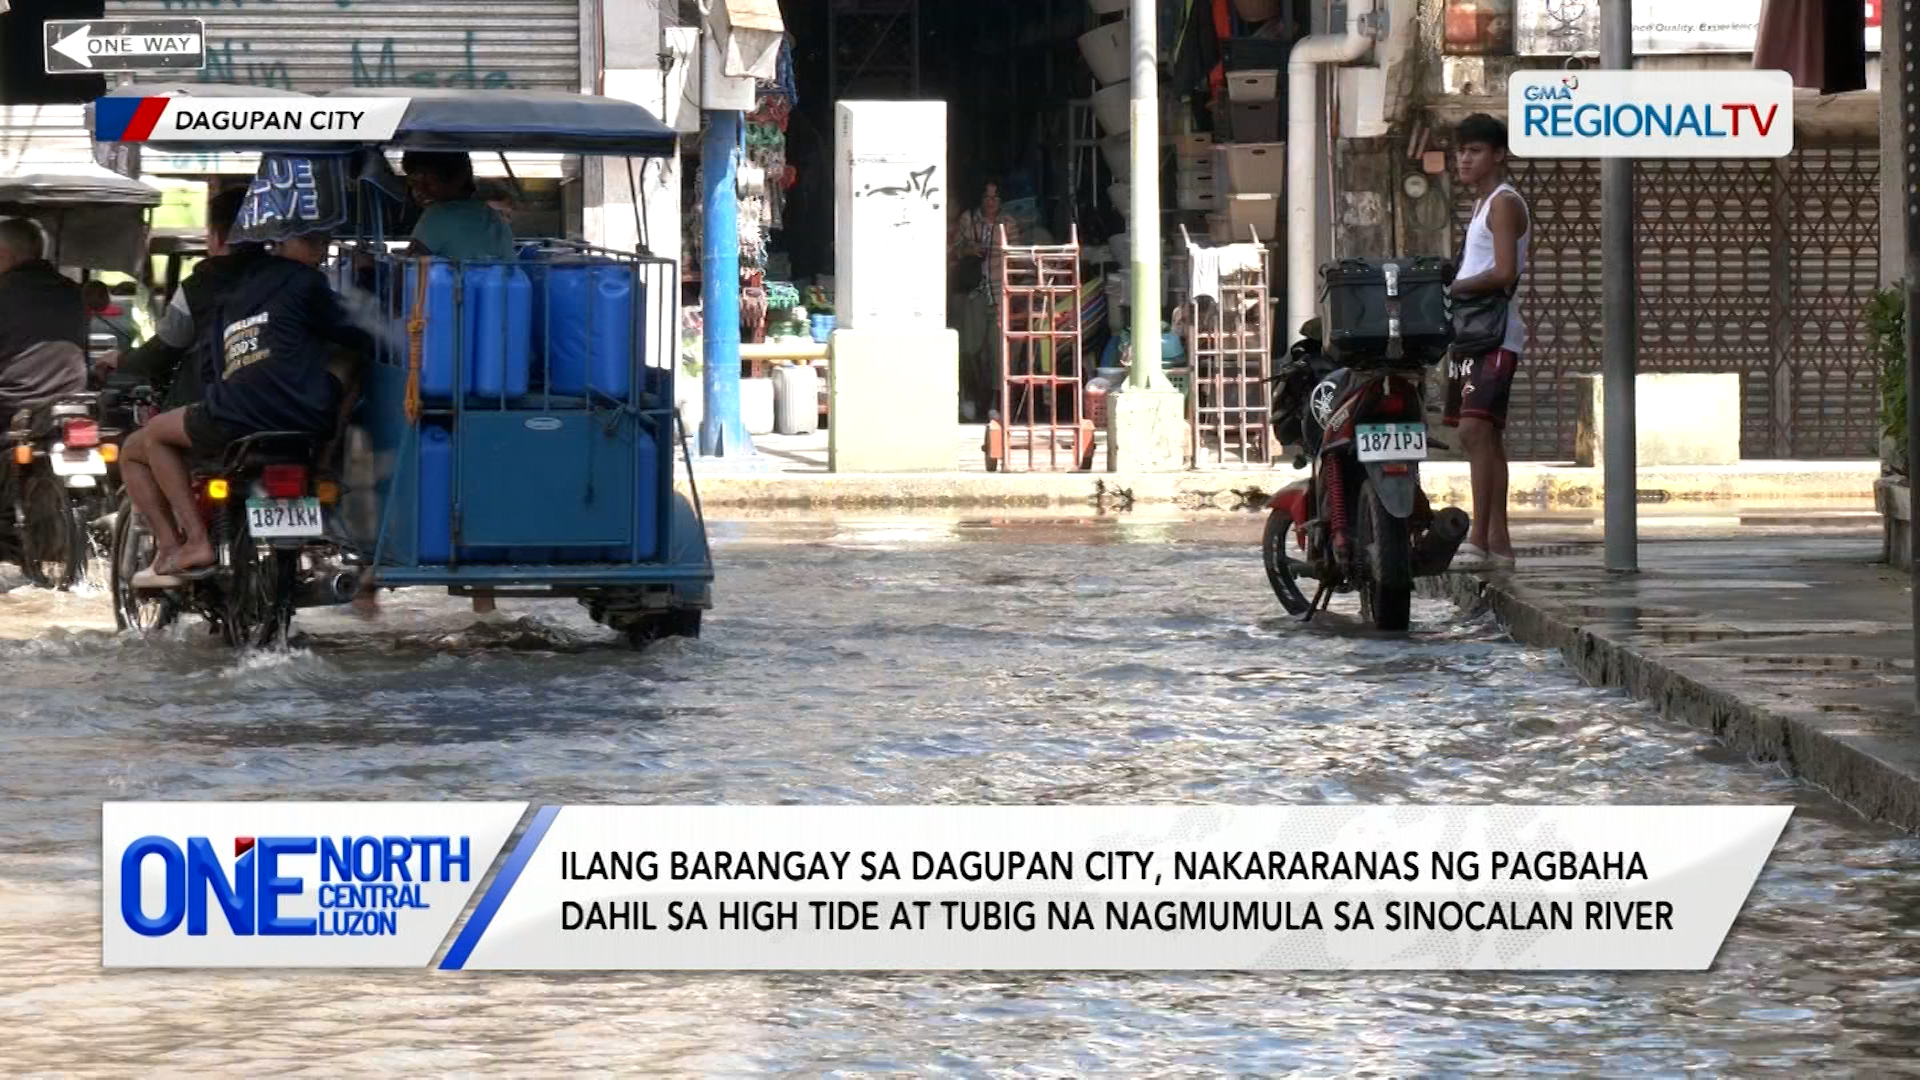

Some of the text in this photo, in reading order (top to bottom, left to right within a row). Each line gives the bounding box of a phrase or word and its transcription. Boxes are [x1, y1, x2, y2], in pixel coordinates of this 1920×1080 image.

[87, 36, 191, 55] ONE WAY
[253, 158, 315, 193] LUE
